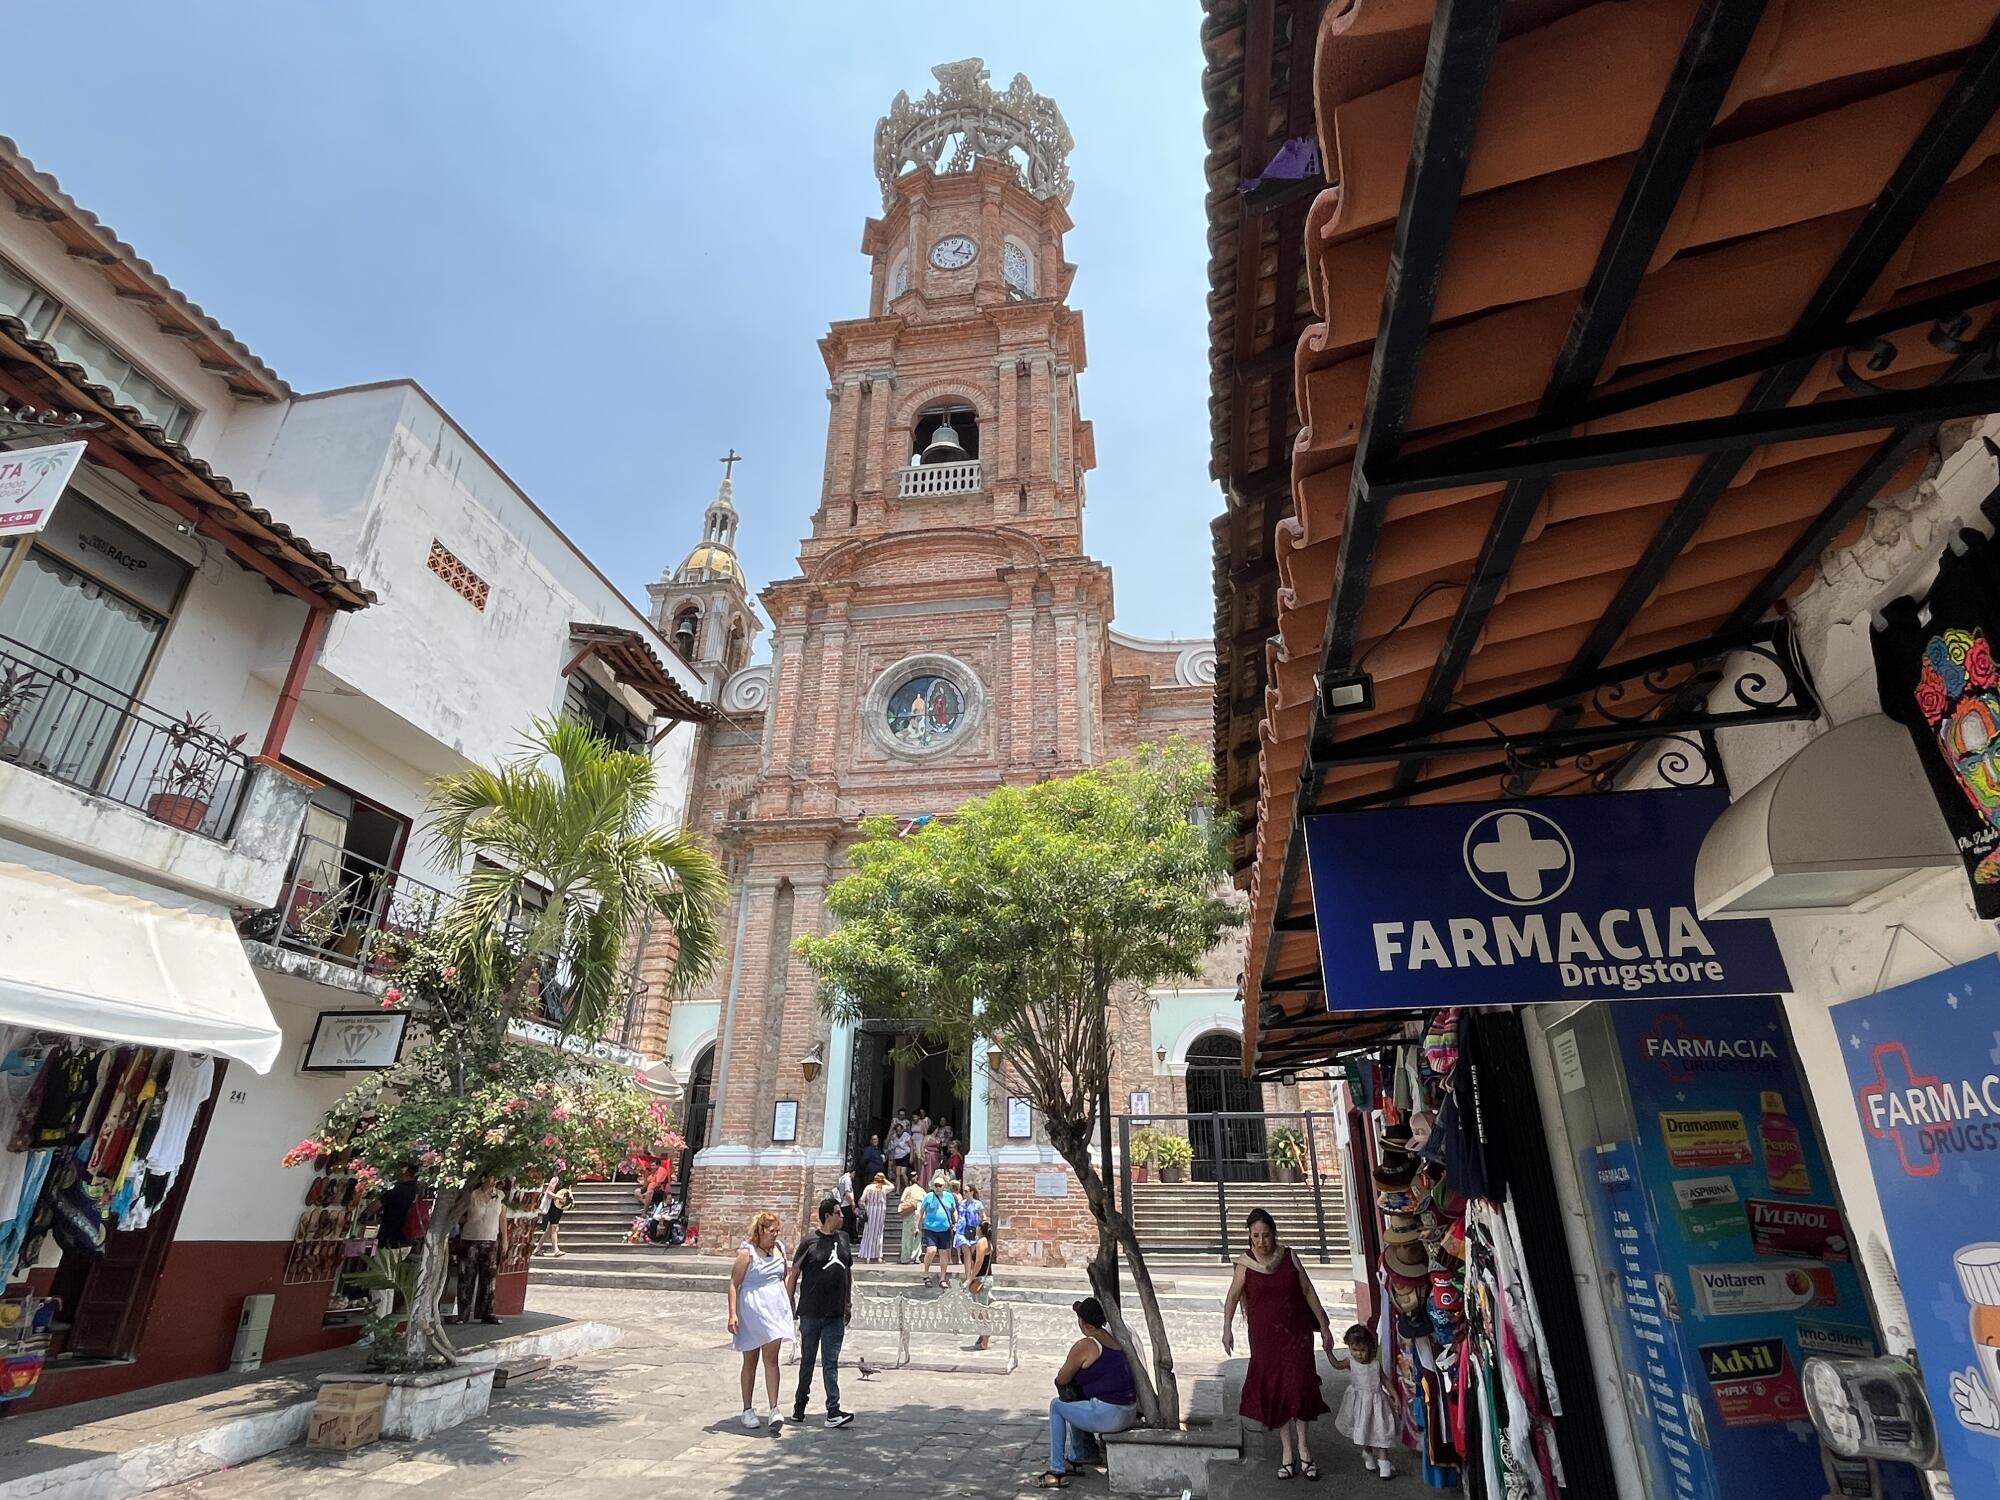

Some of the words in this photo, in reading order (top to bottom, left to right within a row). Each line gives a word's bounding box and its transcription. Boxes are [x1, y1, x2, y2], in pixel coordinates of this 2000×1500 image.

[1372, 906, 1716, 971] FARMACIA
[1559, 959, 1724, 991] Drugstore
[1646, 1038, 1777, 1058] FARMACIA
[1682, 1059, 1782, 1073] DRUGSTORE
[230, 1090, 246, 1101] 241
[1666, 1118, 1740, 1133] Dramamine
[1690, 1184, 1732, 1198] ASPIRINA
[1753, 1204, 1829, 1229] TYLENOL
[1704, 1274, 1766, 1289] Voltaren
[1799, 1326, 1864, 1347] Imodium
[1710, 1345, 1774, 1375] Advil
